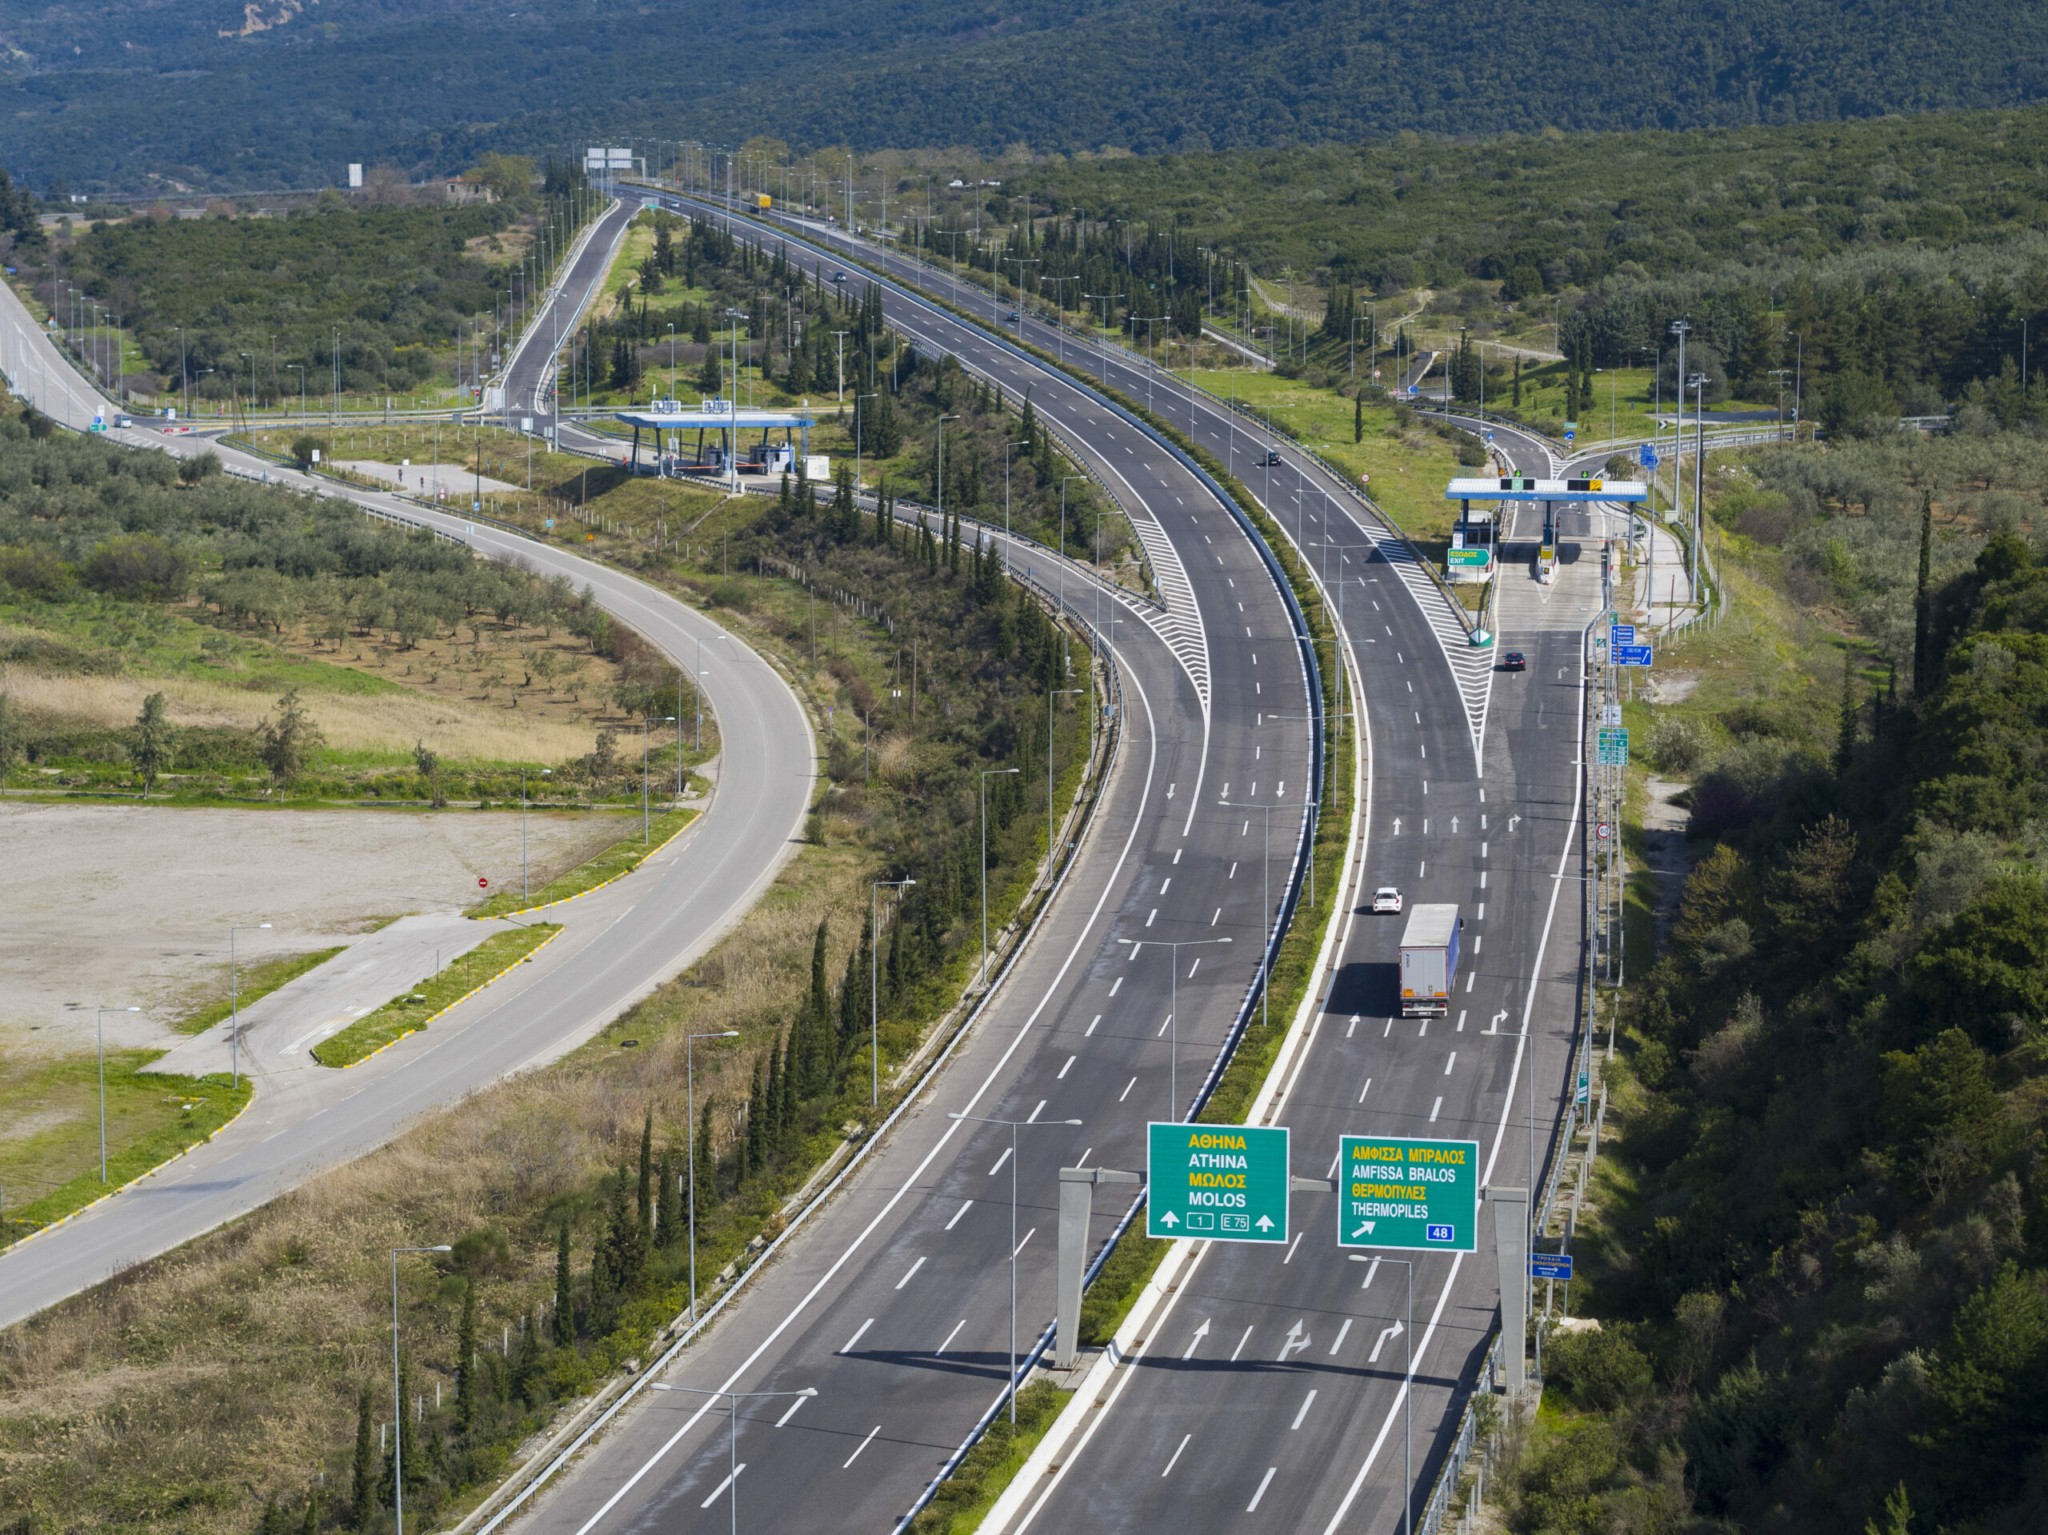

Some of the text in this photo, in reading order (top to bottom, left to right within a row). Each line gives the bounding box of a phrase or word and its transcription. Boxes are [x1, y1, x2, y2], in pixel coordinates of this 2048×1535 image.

[1188, 1134, 1247, 1150] ΑΘΗΝΑ
[1188, 1153, 1248, 1169] ATHINA
[1352, 1146, 1466, 1165] ΑΜΦΙΣΣΑ ΜΠΡΑΛΟΣ
[1189, 1172, 1247, 1188] ΜΩΛΟΣ
[1352, 1165, 1456, 1183] AMFISSA BRALOS
[1189, 1192, 1246, 1207] MOLOS
[1352, 1183, 1427, 1200] ΘΕΡΜΟΠΥΛΕΣ
[1351, 1202, 1429, 1219] THERMOPILES
[1197, 1216, 1202, 1227] 1
[1432, 1227, 1448, 1239] 48
